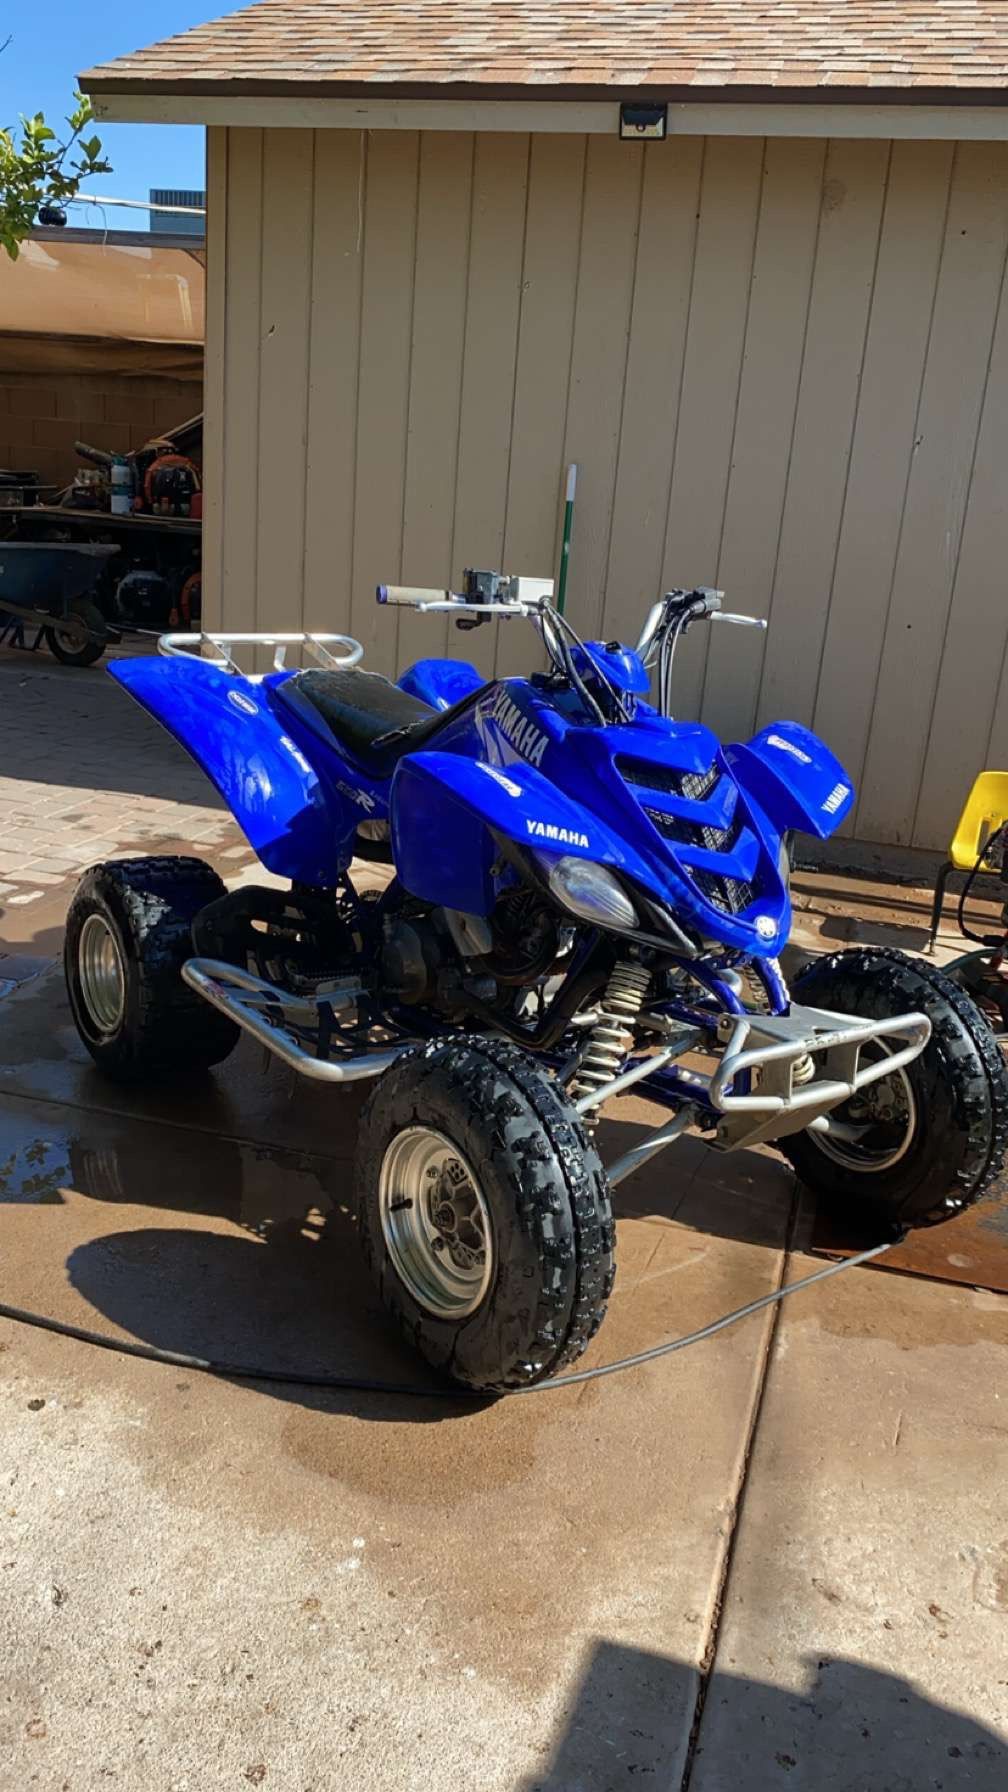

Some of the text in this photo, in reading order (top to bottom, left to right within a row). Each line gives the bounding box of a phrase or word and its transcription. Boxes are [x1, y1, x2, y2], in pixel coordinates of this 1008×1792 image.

[494, 689, 549, 768] YAMAHA
[821, 783, 850, 814] YAMAHA
[526, 819, 589, 848] YAMAHA
